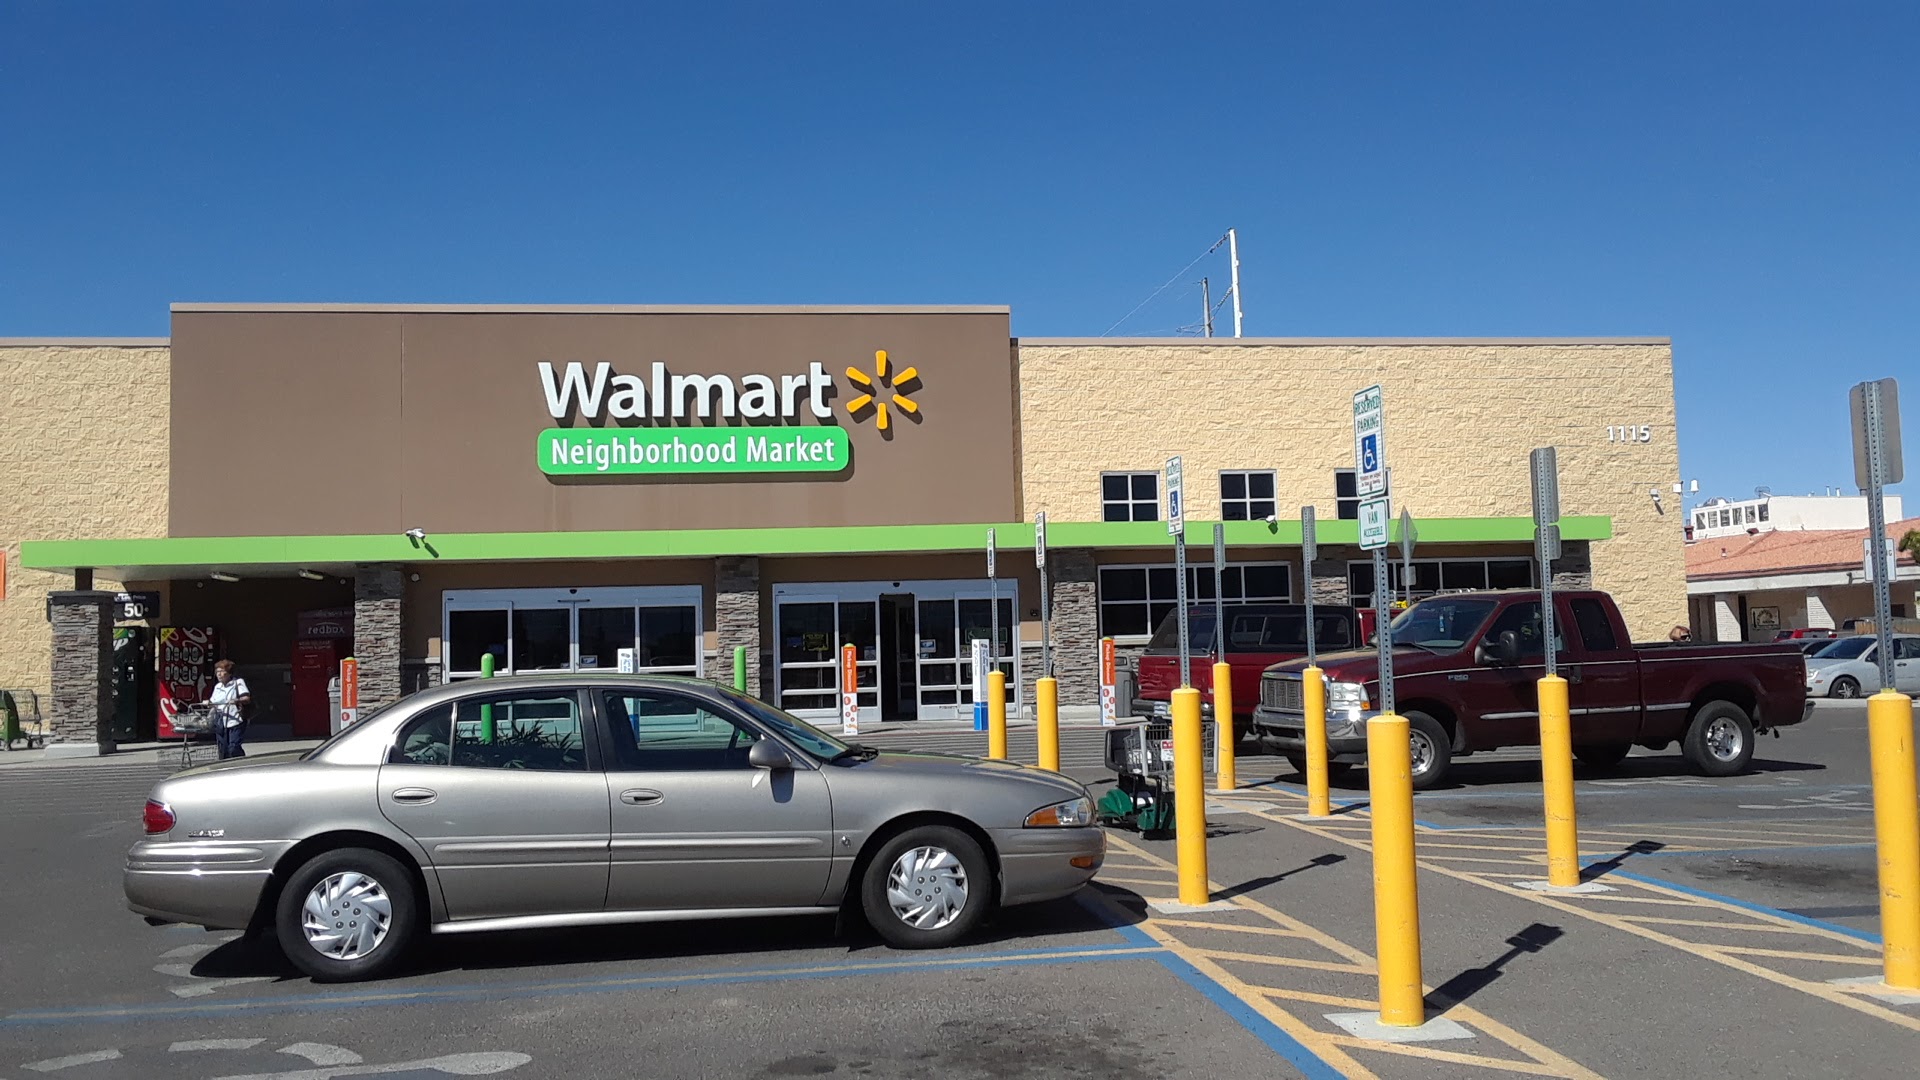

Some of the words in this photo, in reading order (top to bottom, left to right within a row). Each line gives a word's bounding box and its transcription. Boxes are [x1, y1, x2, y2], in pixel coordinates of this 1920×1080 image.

[537, 361, 832, 419] Walmart
[1354, 395, 1380, 415] RESERVED
[1357, 413, 1379, 434] PARKING
[1607, 425, 1650, 442] 1115
[551, 435, 737, 471] Neighborhood
[746, 435, 836, 463] Market
[1367, 510, 1379, 524] VAN
[307, 624, 345, 635] redbox
